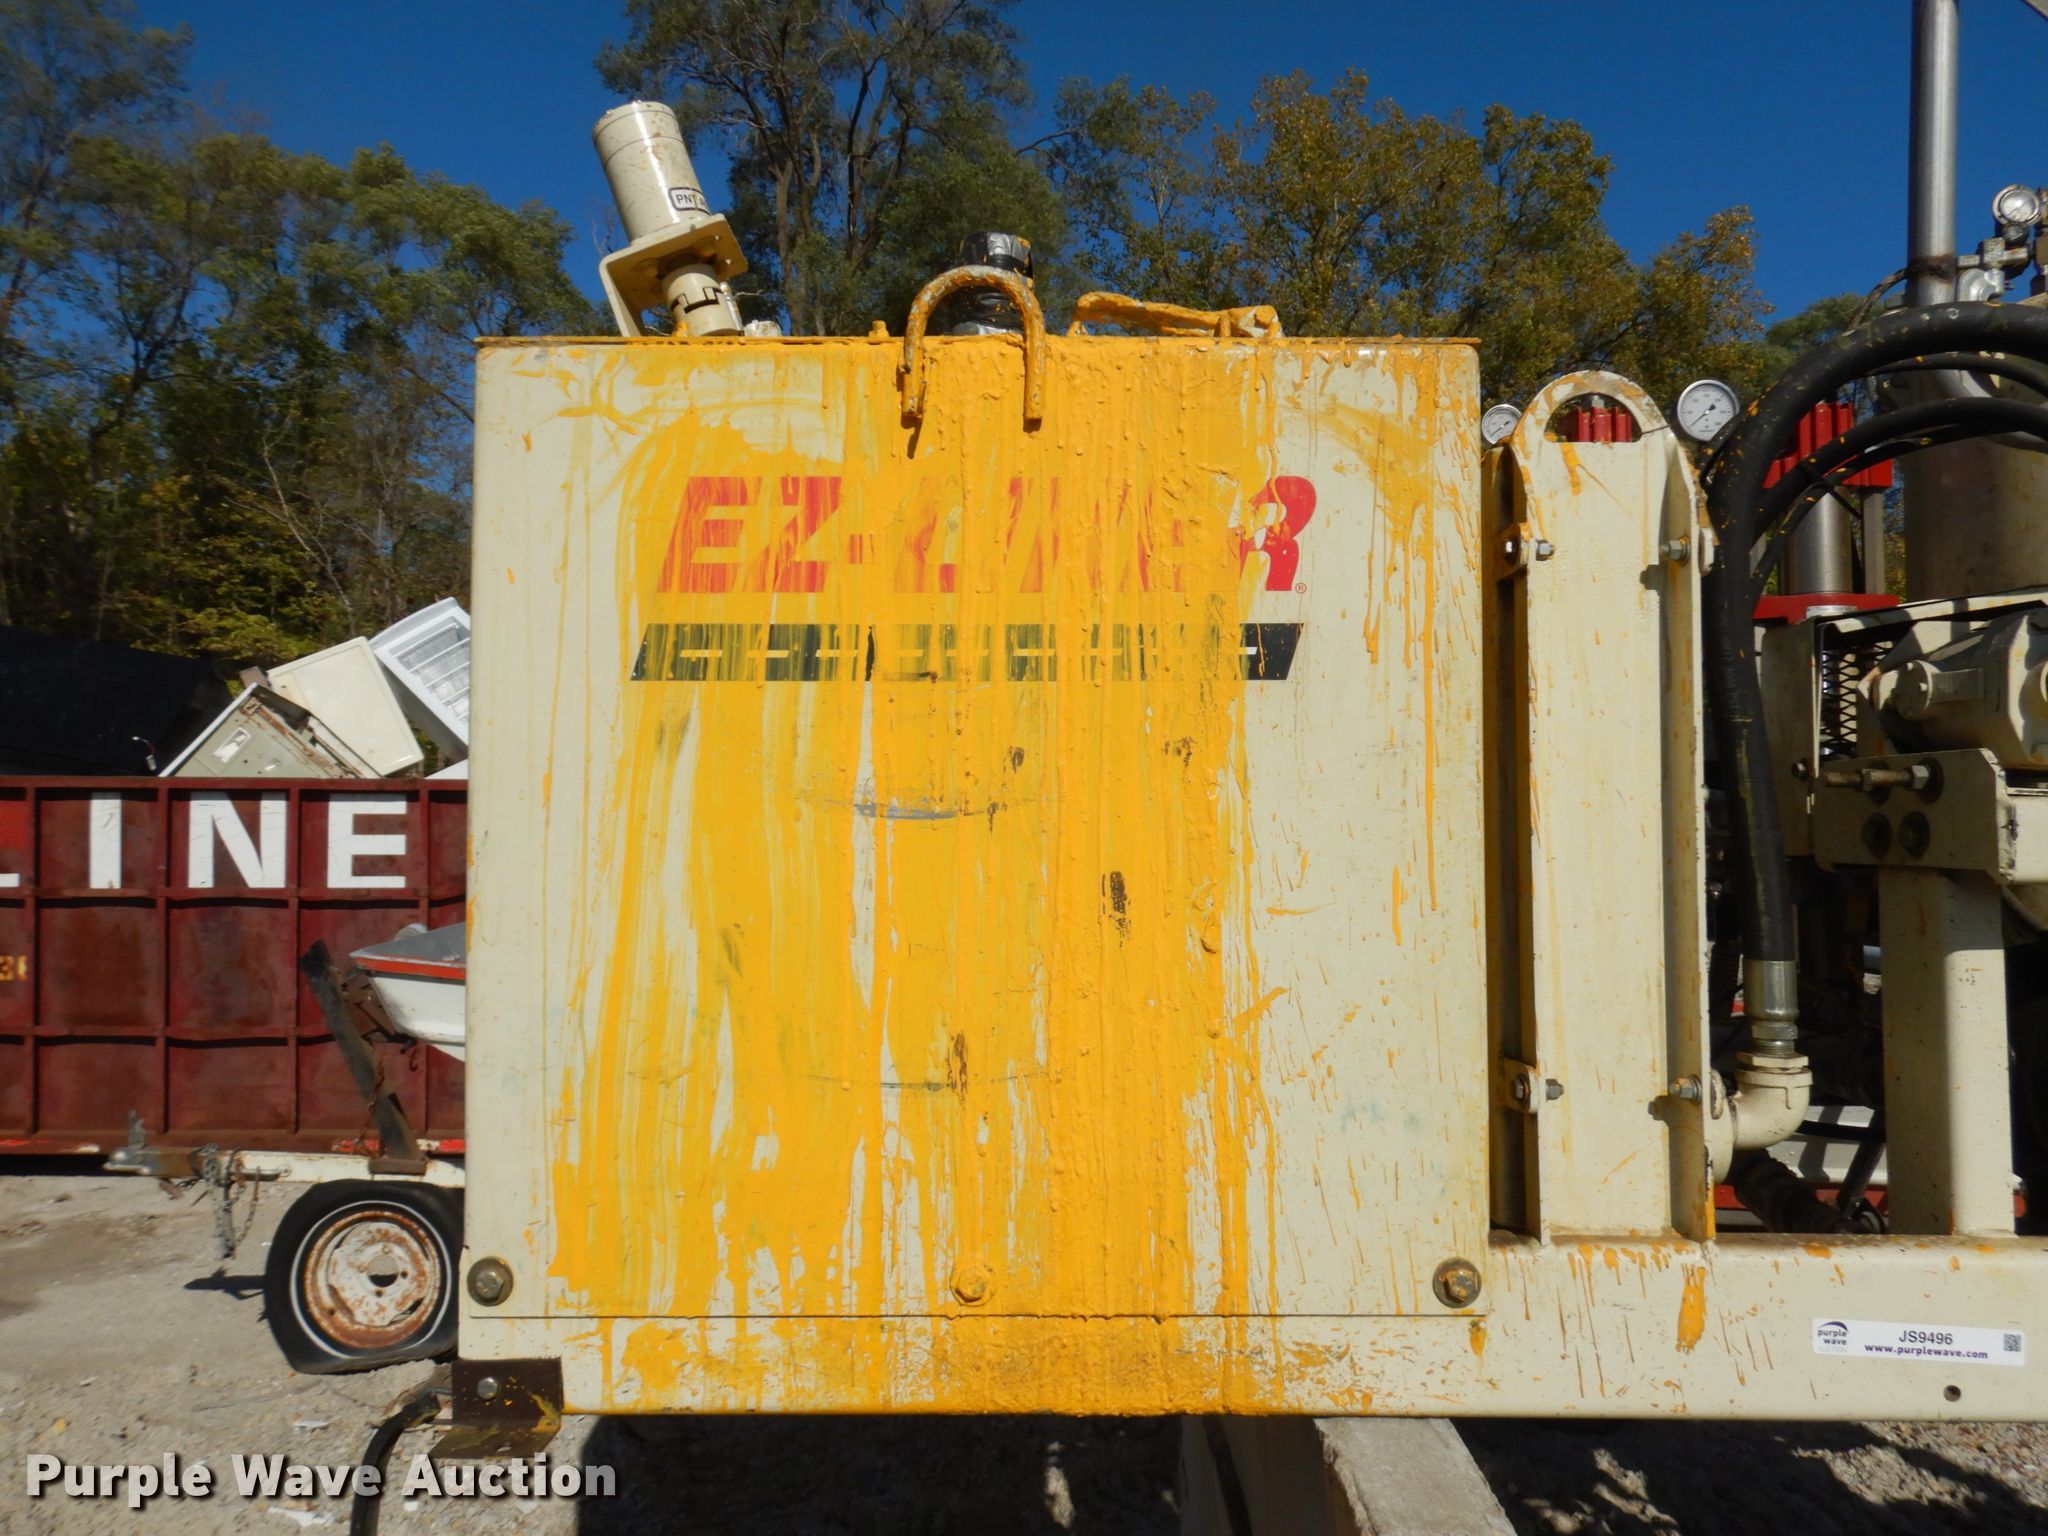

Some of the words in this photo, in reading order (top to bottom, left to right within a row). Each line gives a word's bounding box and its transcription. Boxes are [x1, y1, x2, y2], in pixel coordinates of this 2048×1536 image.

[1818, 1329, 1847, 1338] purple
[1899, 1330, 1953, 1345] JS9496
[1864, 1344, 1988, 1359] www.purplewave.com
